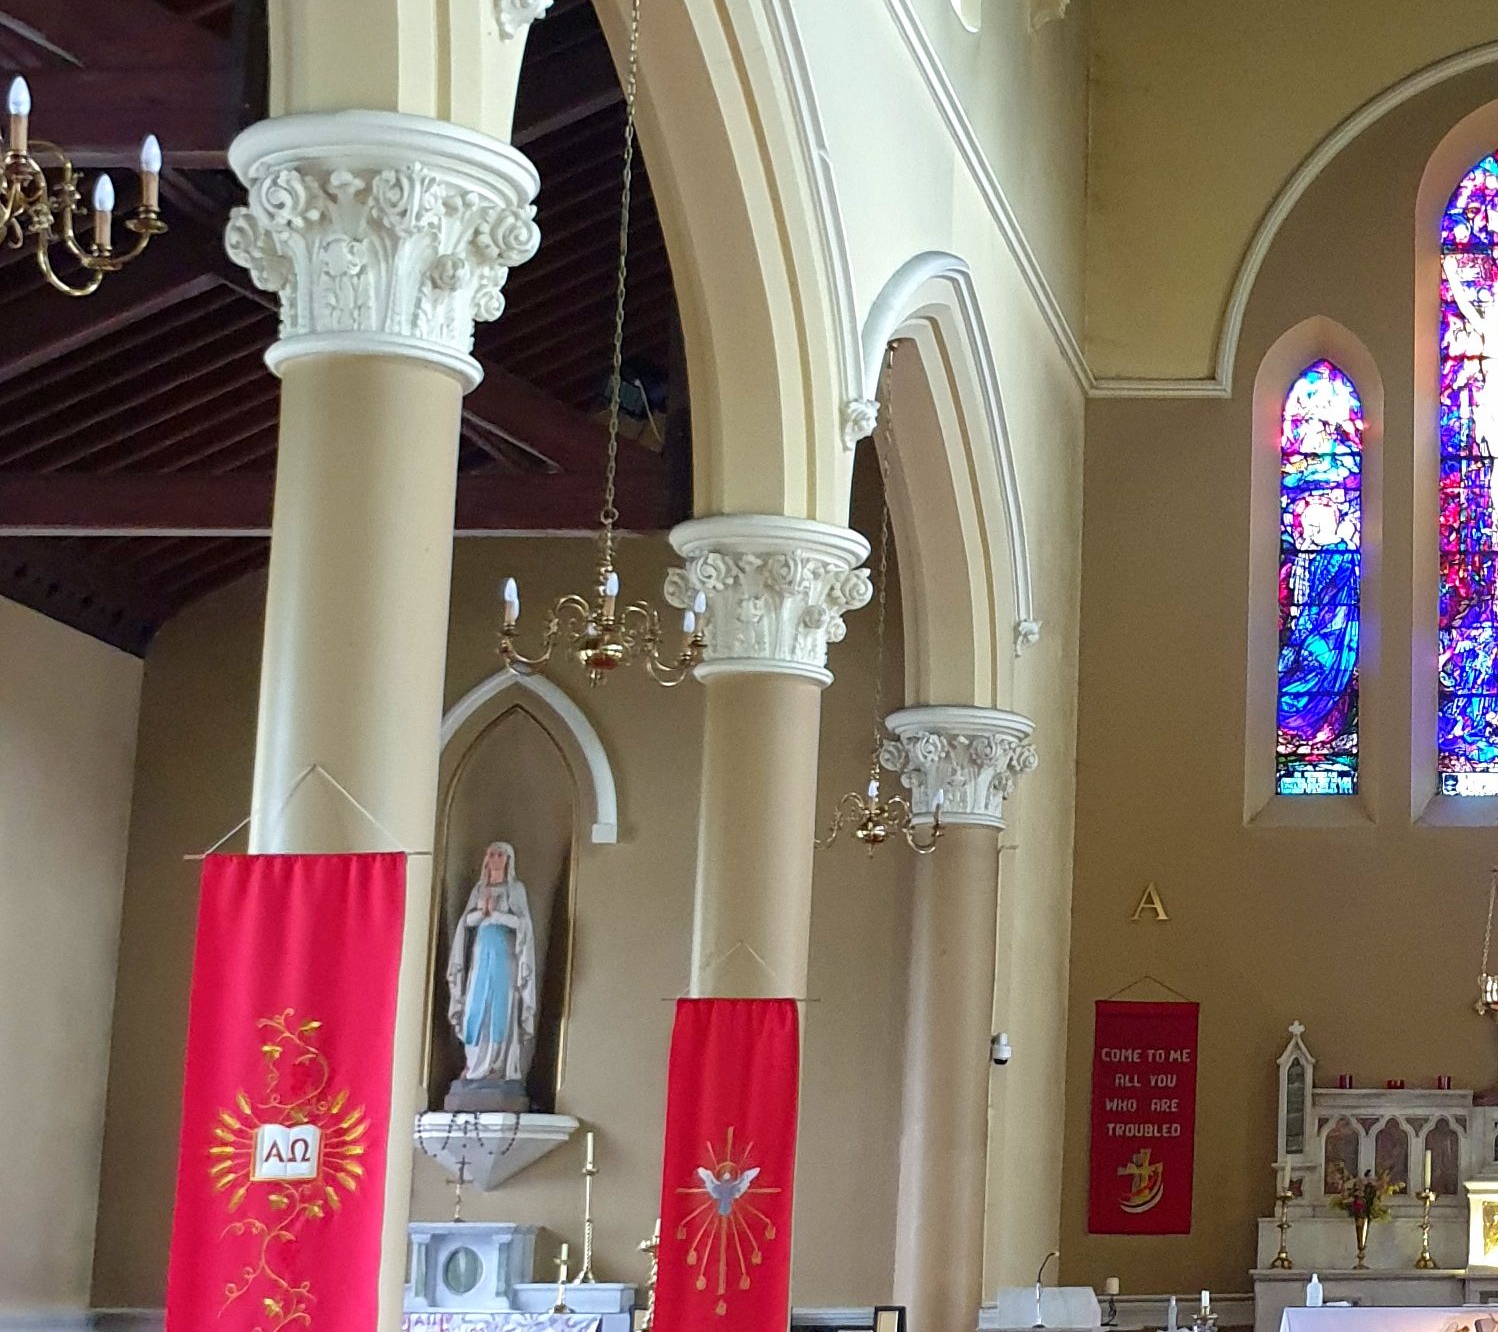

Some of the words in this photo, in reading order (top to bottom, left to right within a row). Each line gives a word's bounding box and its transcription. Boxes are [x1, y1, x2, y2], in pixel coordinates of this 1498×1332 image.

[1101, 1048, 1142, 1062] COME
[1146, 1049, 1165, 1063] TO
[1169, 1049, 1191, 1063] ME
[1115, 1073, 1142, 1087] ALL
[1149, 1074, 1177, 1087] YOU
[1105, 1098, 1137, 1112] WHO
[1151, 1099, 1179, 1112] ARE
[1106, 1123, 1181, 1137] TROUBLED
